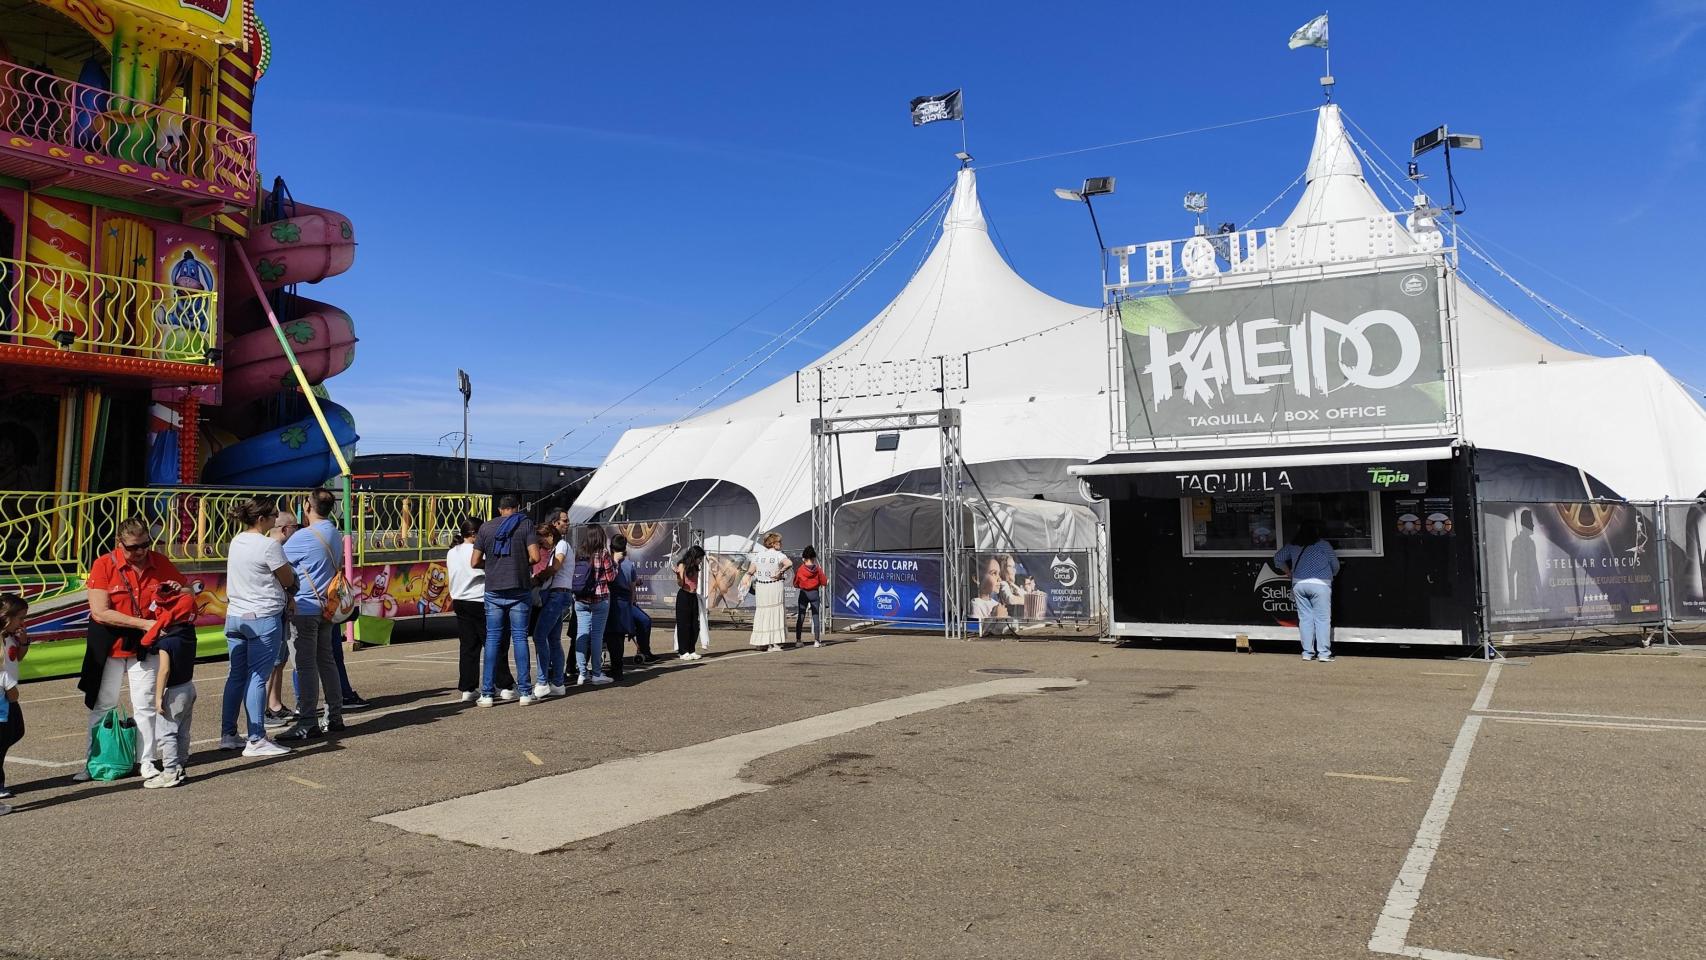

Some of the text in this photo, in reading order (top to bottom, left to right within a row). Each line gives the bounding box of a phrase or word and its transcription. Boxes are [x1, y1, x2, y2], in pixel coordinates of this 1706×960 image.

[1111, 207, 1443, 286] TAQUILLAS
[1142, 309, 1421, 412] KALEIDO
[1188, 412, 1265, 427] TAQUILLA
[1285, 408, 1319, 422] BOX
[1327, 405, 1386, 420] OFFICE
[1175, 470, 1294, 494] TAQUILLA
[1367, 469, 1410, 488] Tapia
[857, 558, 918, 571] ACCESO CARPA
[1546, 556, 1641, 569] STELLAR CIRCUS
[857, 571, 918, 582] ENTRADA PRINCIPAL
[1053, 572, 1071, 580] Circus
[1261, 585, 1292, 599] Stella
[876, 602, 893, 610] Circus
